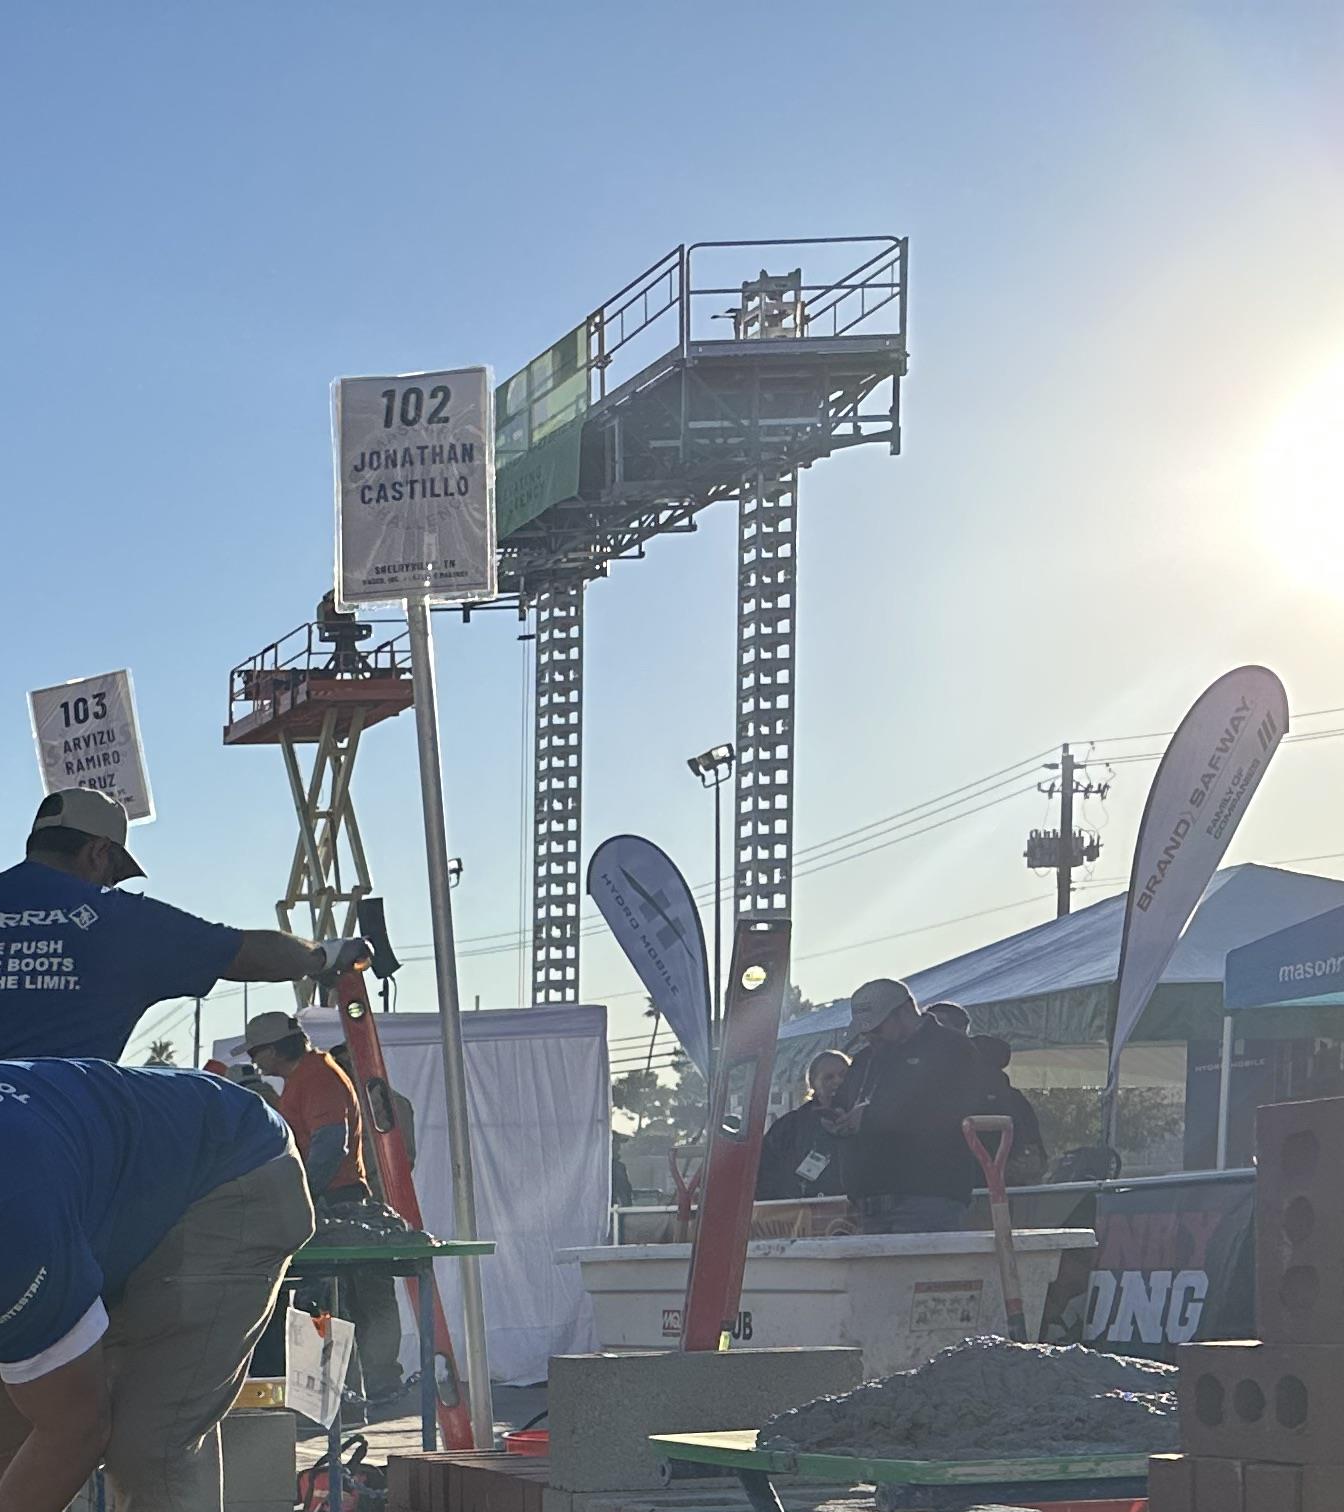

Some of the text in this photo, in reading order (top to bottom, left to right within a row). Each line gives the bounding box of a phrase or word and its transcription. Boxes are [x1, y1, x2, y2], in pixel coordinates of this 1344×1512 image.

[381, 385, 452, 428] 102
[353, 443, 475, 473] JONATHAN
[360, 476, 469, 505] CASTILLO
[60, 692, 108, 728] 103
[63, 729, 116, 754] ARVIZU
[65, 750, 121, 776] RAMIRO
[1137, 696, 1253, 913] BRAND SAFWAY
[10, 940, 63, 955] PUSH
[7, 957, 74, 972] BOOTS
[25, 975, 81, 990] LIMIT.
